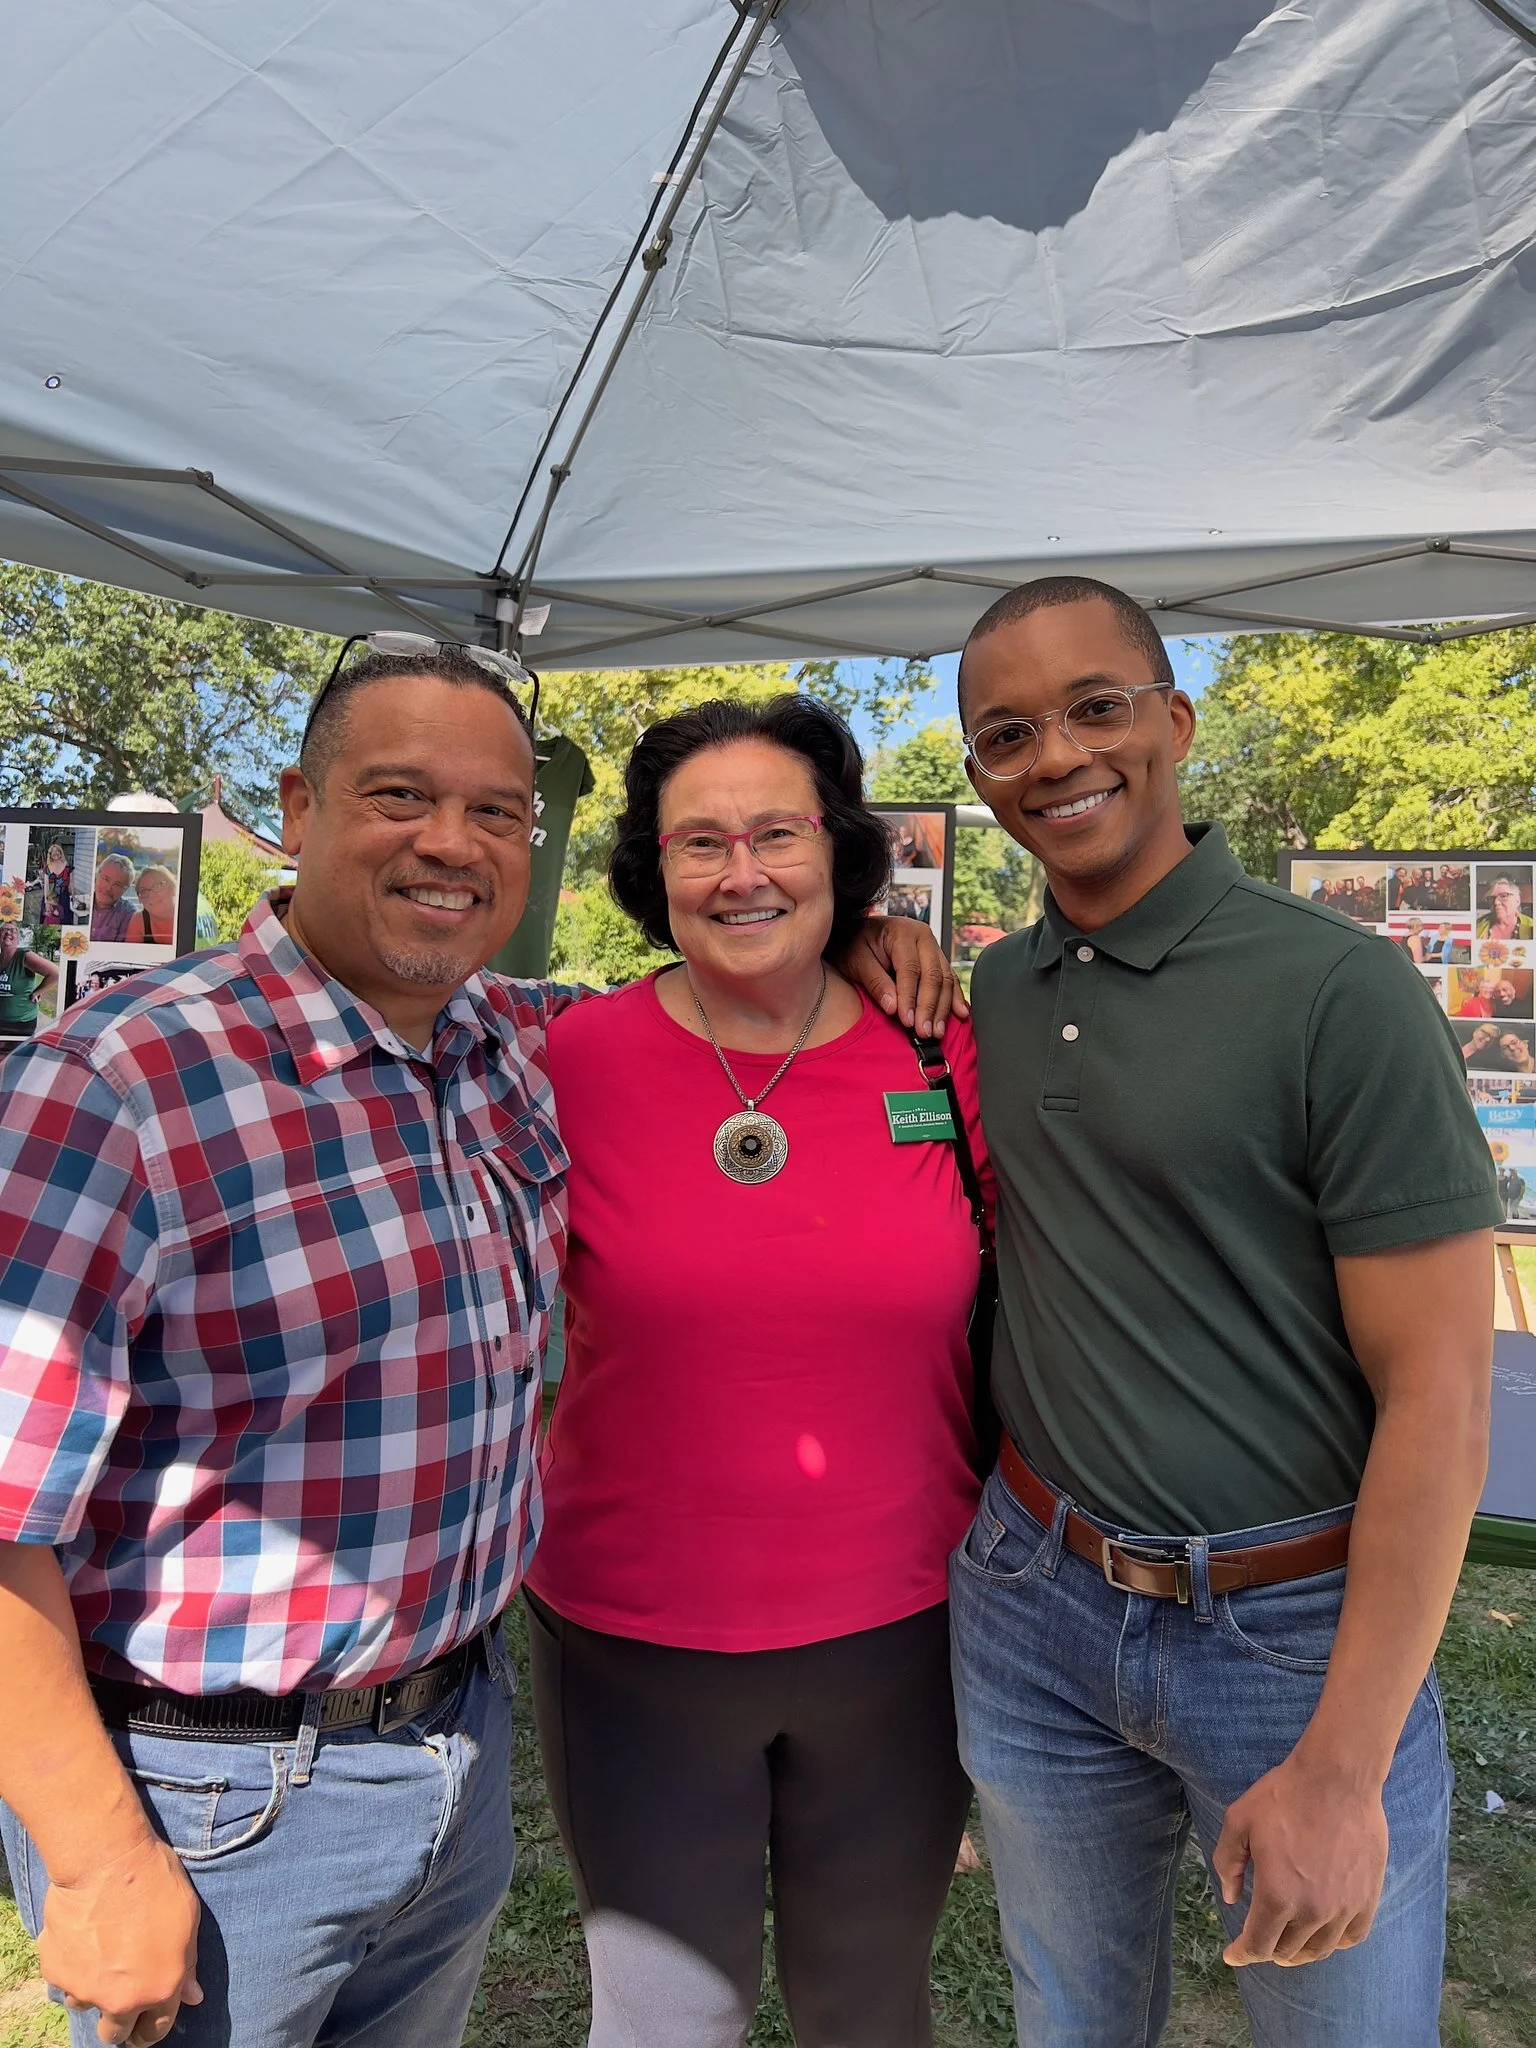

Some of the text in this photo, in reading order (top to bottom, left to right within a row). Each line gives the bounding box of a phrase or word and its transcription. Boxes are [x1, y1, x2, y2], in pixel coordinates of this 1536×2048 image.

[892, 1113, 918, 1125] Keith
[919, 1112, 952, 1123] Ellison
[1488, 1109, 1524, 1120] Betsy
